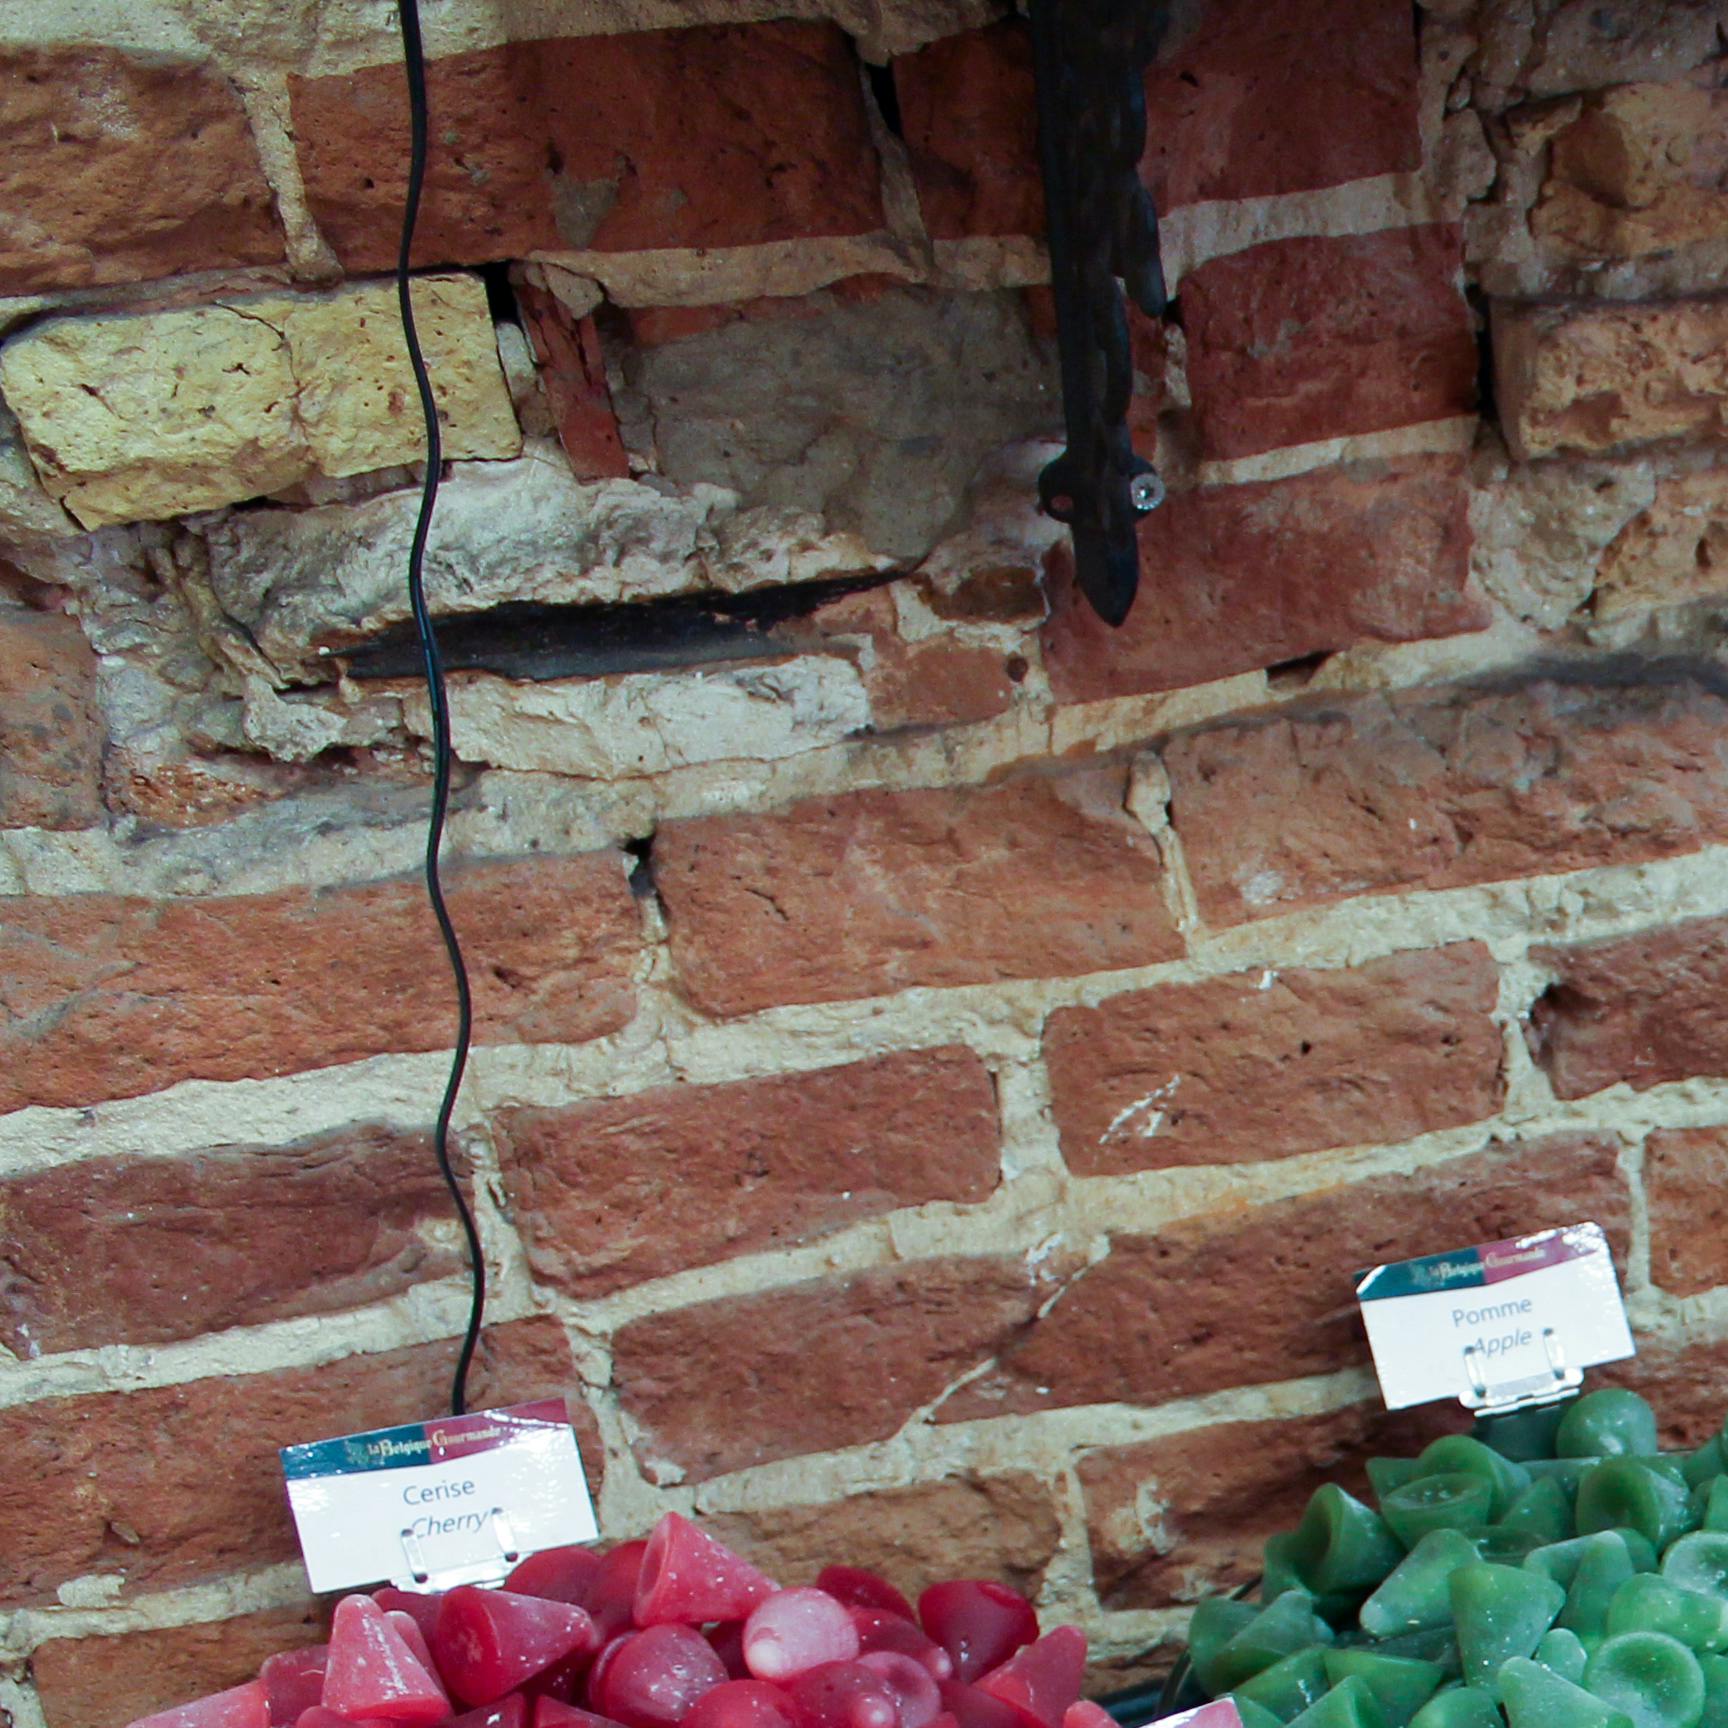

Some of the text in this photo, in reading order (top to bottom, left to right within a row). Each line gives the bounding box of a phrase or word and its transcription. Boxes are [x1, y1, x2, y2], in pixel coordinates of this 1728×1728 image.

[1451, 1298, 1533, 1328] Pomme
[1473, 1328, 1533, 1358] Apple
[402, 1479, 476, 1506] Cerise
[412, 1510, 489, 1539] Cherry
